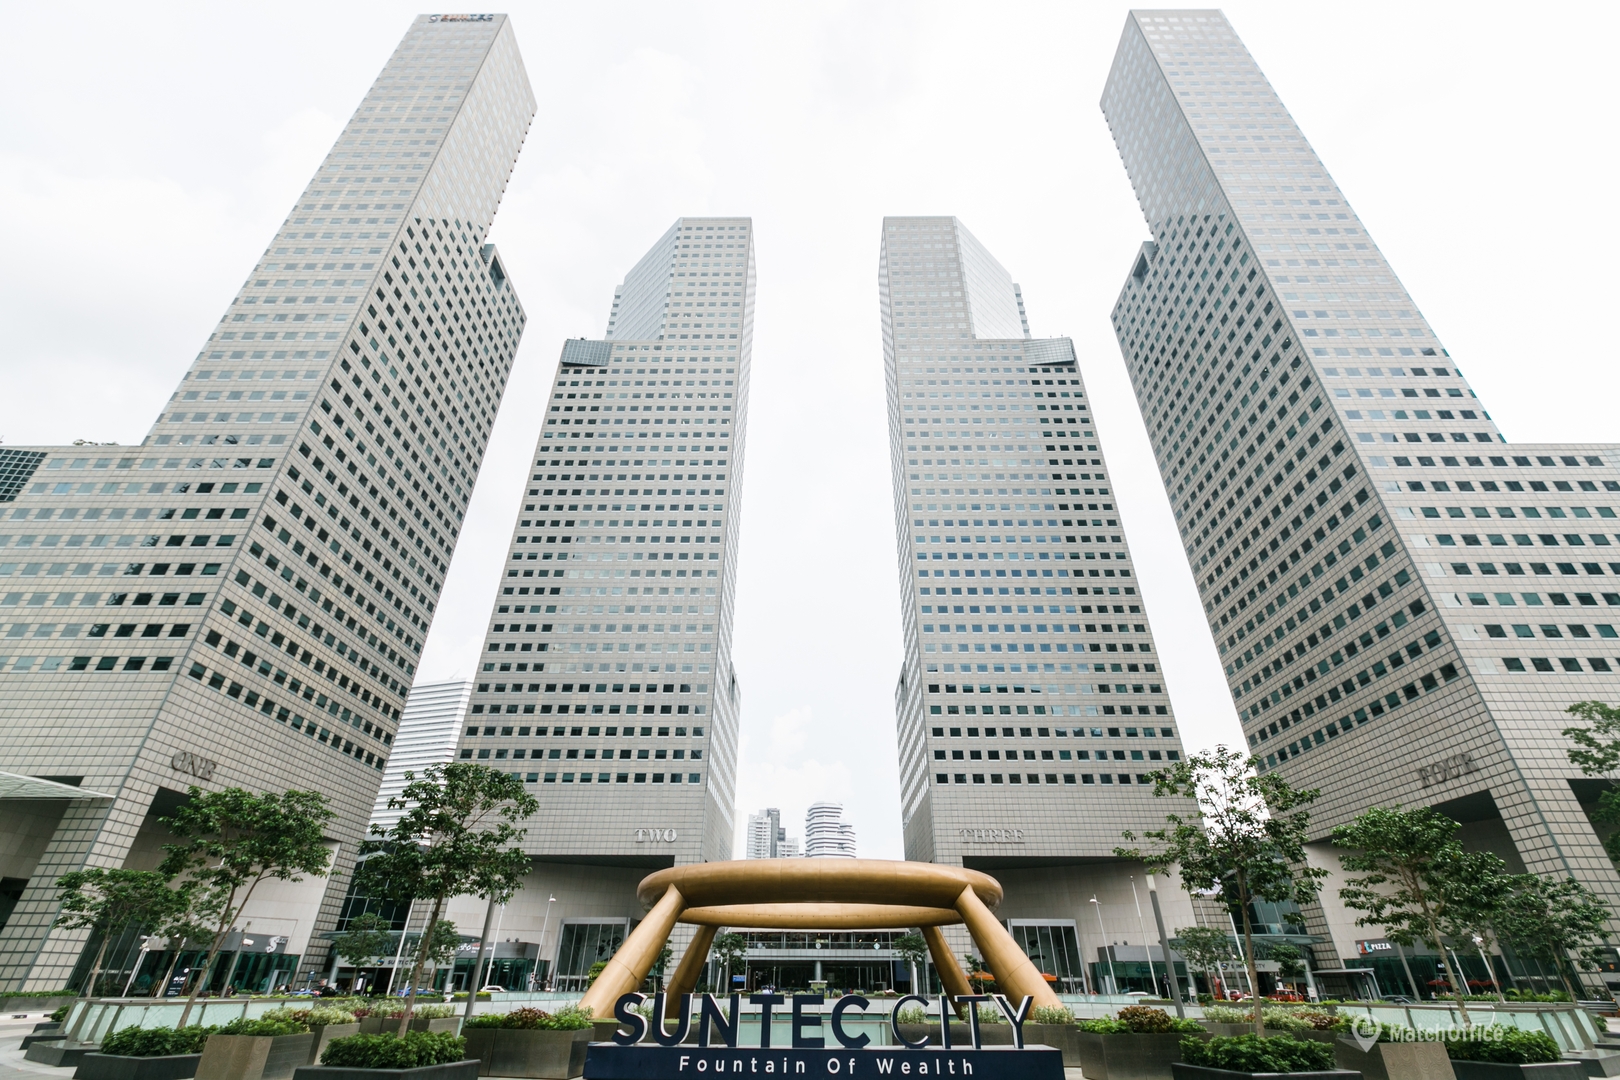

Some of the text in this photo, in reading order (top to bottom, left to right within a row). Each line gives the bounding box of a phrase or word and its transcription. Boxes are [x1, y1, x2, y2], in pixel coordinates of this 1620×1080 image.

[171, 750, 217, 781] ONE
[1415, 753, 1478, 788] FOUR
[635, 828, 677, 843] TWO
[959, 828, 1025, 844] THREE
[1371, 943, 1392, 951] PIZZA
[611, 992, 1034, 1049] SUNTEC CITY
[679, 1056, 973, 1075] Fountain Of Wealth
